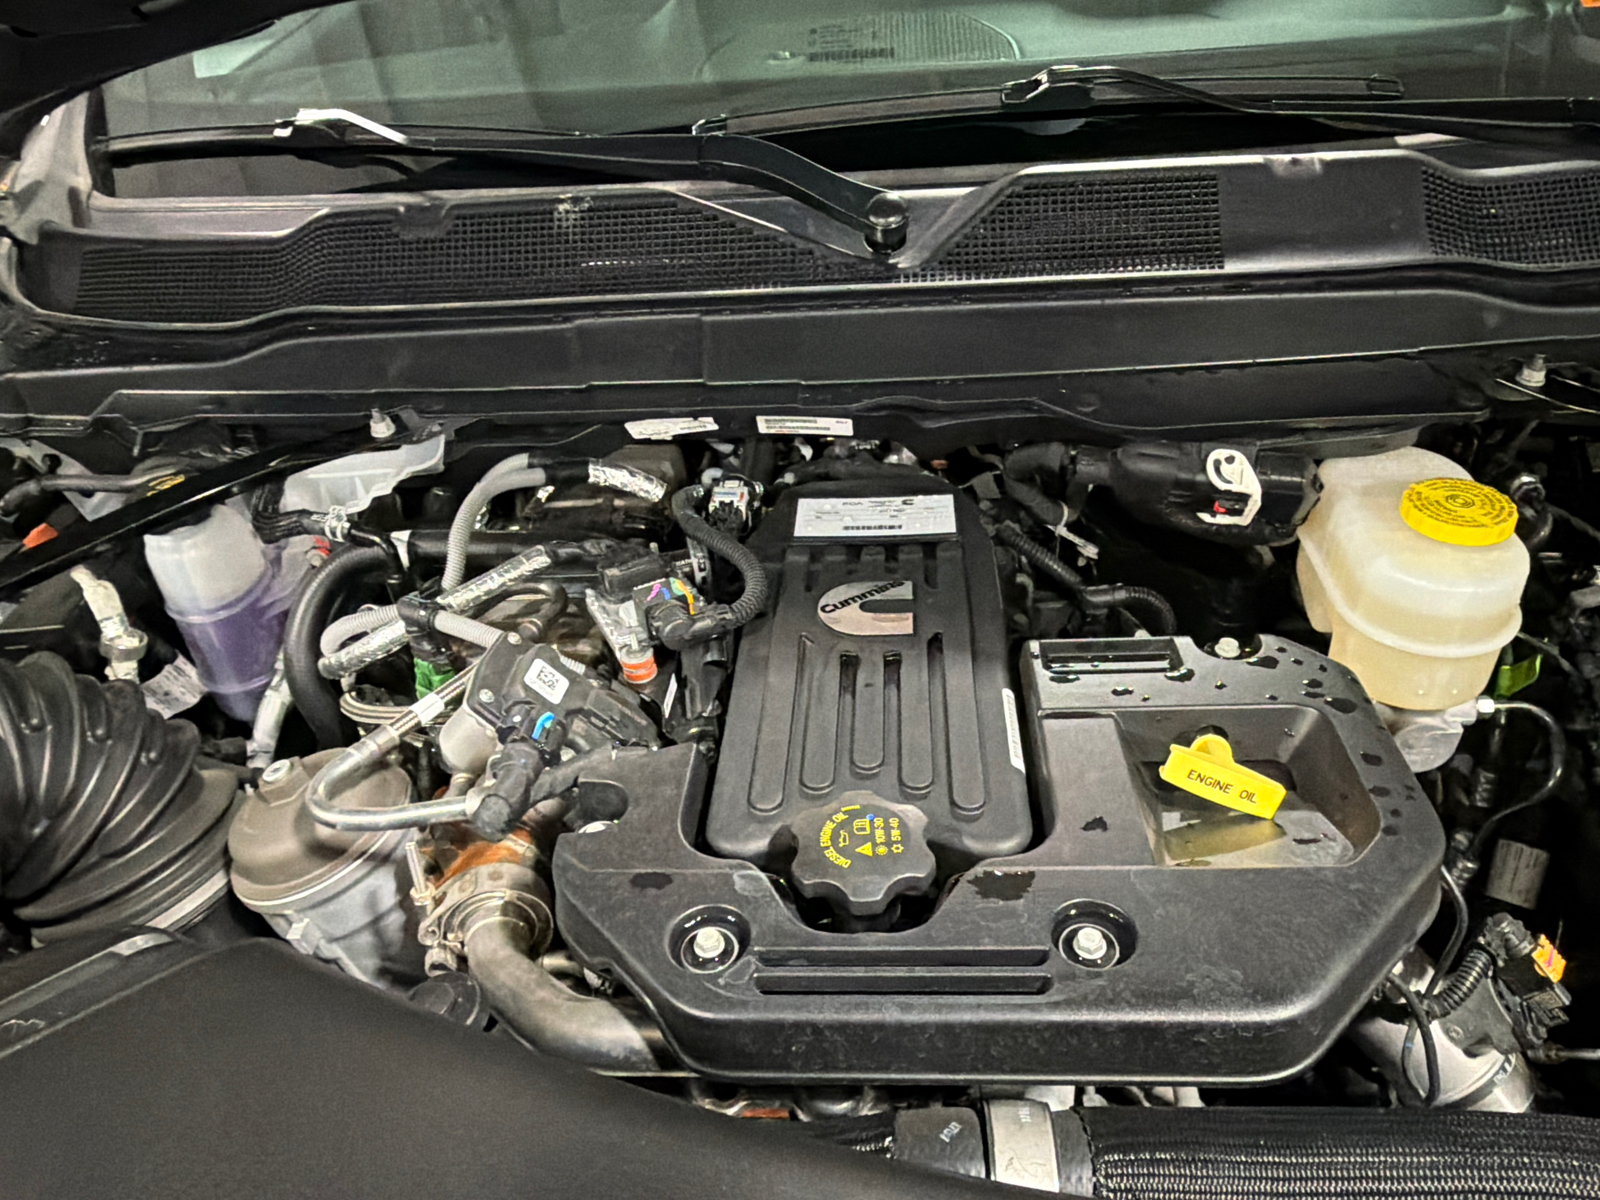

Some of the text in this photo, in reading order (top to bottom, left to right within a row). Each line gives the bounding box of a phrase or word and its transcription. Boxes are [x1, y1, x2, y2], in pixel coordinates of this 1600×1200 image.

[820, 581, 905, 613] Cummins
[1187, 769, 1257, 804] ENGINE OIL
[820, 812, 852, 869] DIESEL ENGINE OIL
[874, 817, 886, 844] 10W-30
[889, 817, 902, 841] 5W-40
